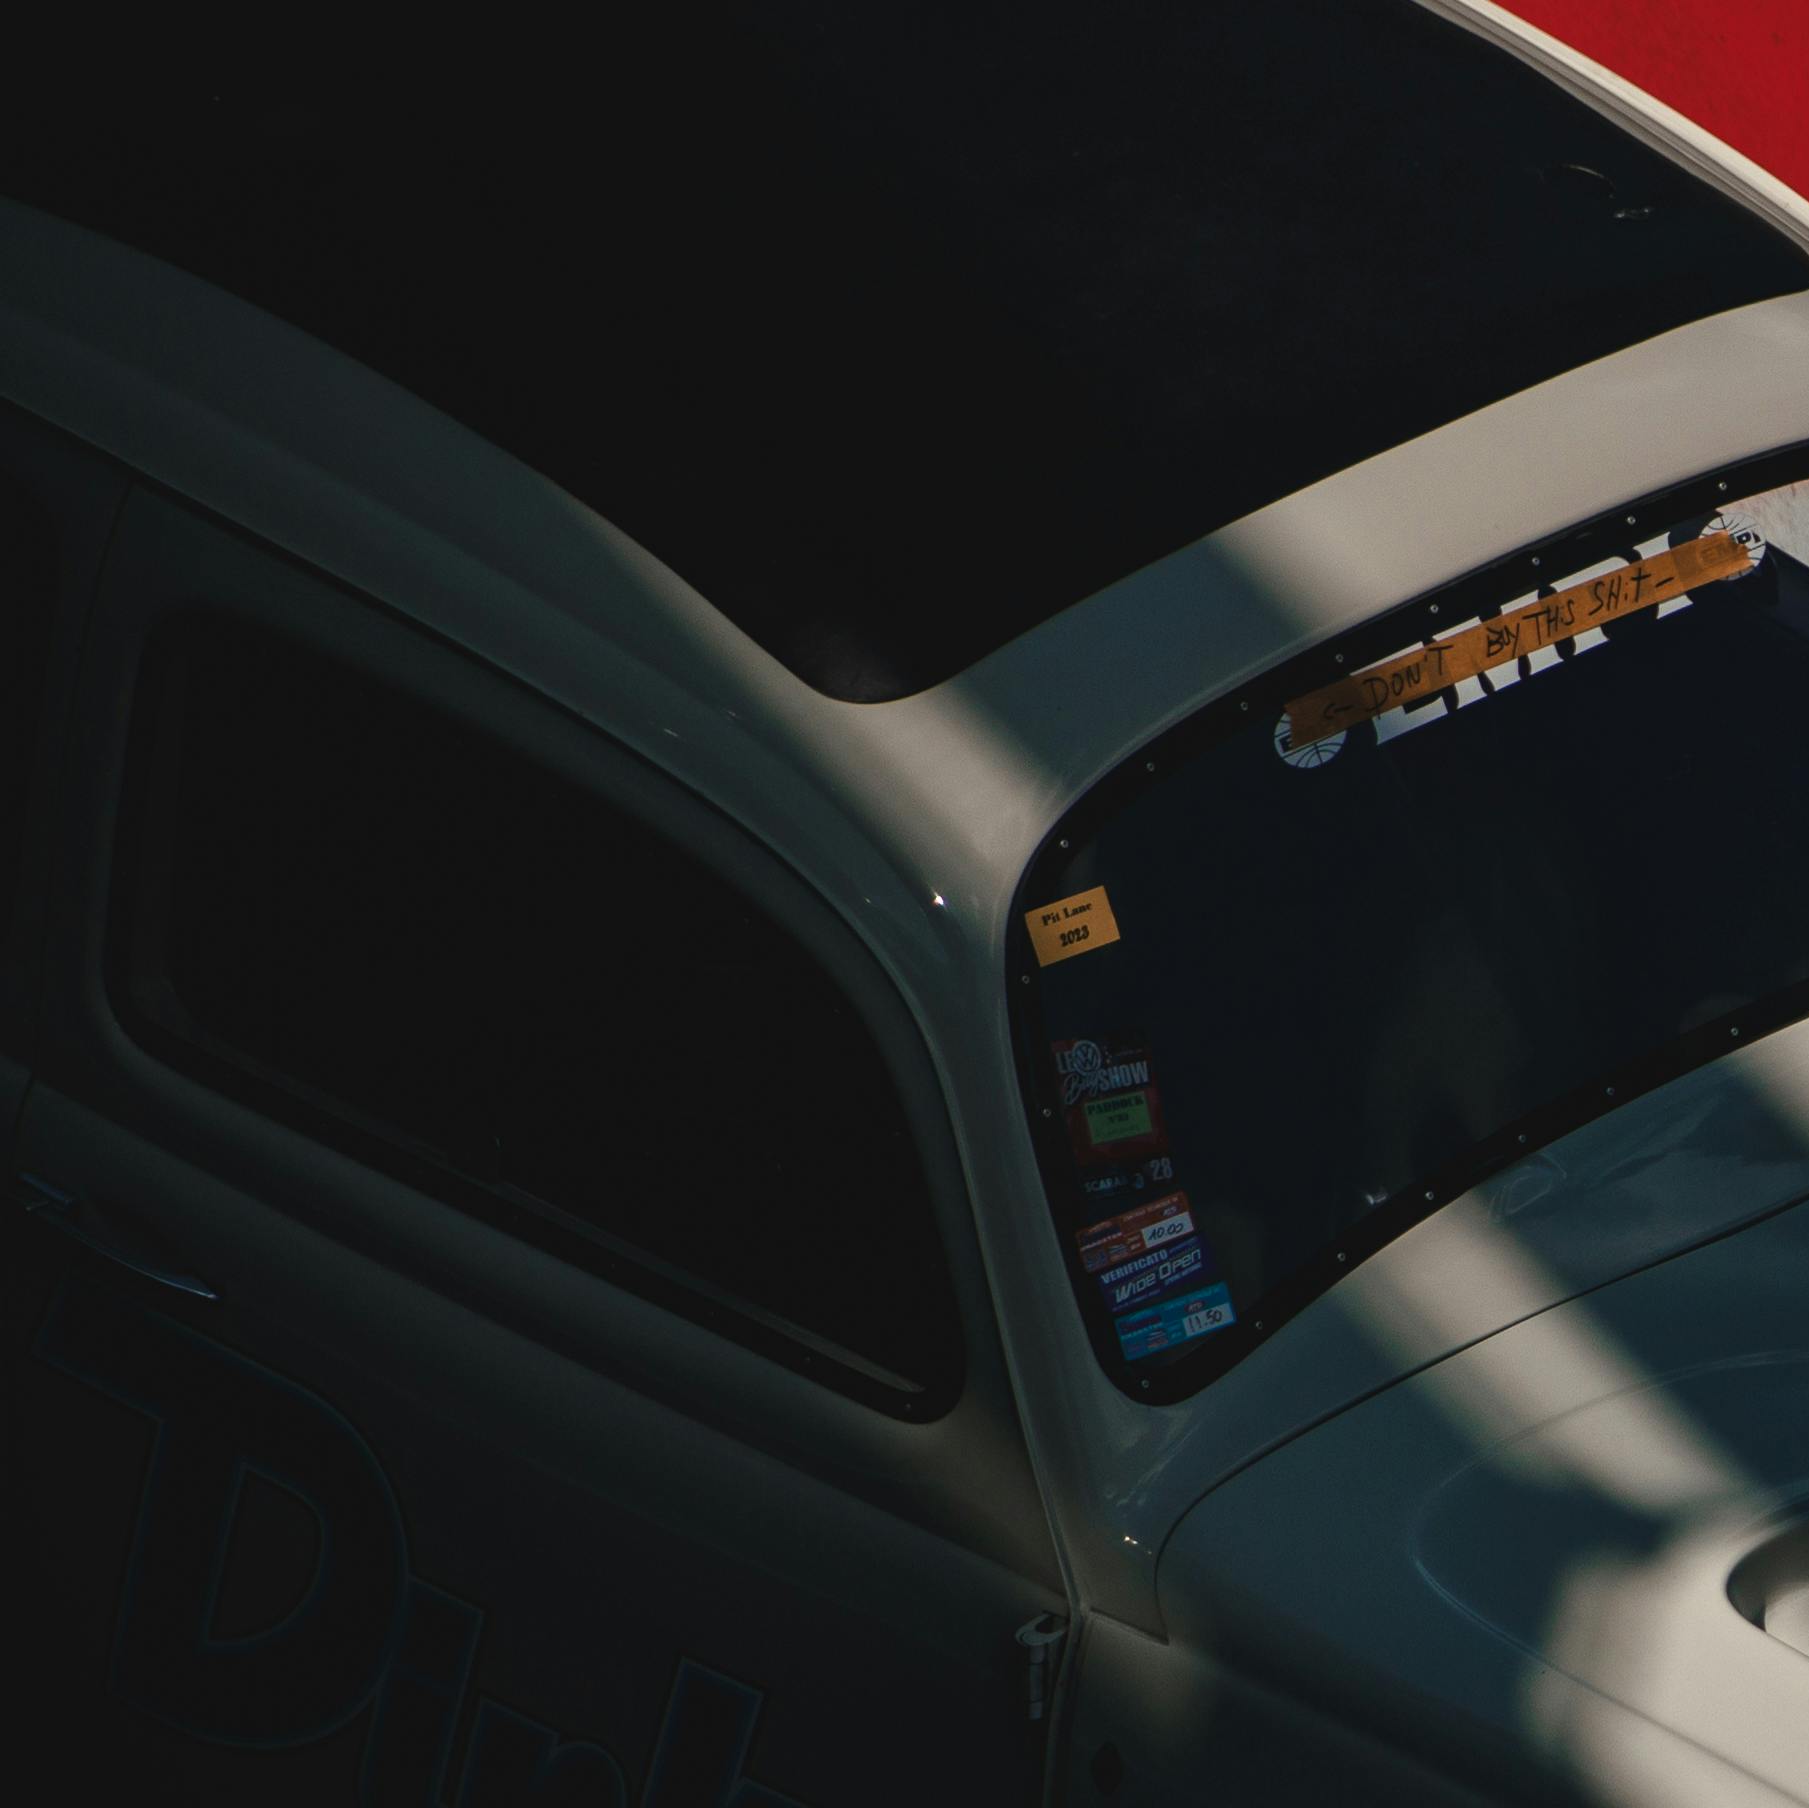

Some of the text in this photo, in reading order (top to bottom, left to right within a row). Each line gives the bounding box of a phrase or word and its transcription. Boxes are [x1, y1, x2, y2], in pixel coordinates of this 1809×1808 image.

[1362, 645, 1453, 720] DON'T
[1041, 903, 1092, 927] Pit Lane
[1060, 925, 1090, 947] 2023
[1098, 1060, 1150, 1091] SHOW
[1149, 1157, 1173, 1181] 28
[1100, 1249, 1168, 1284] VERIFICATO
